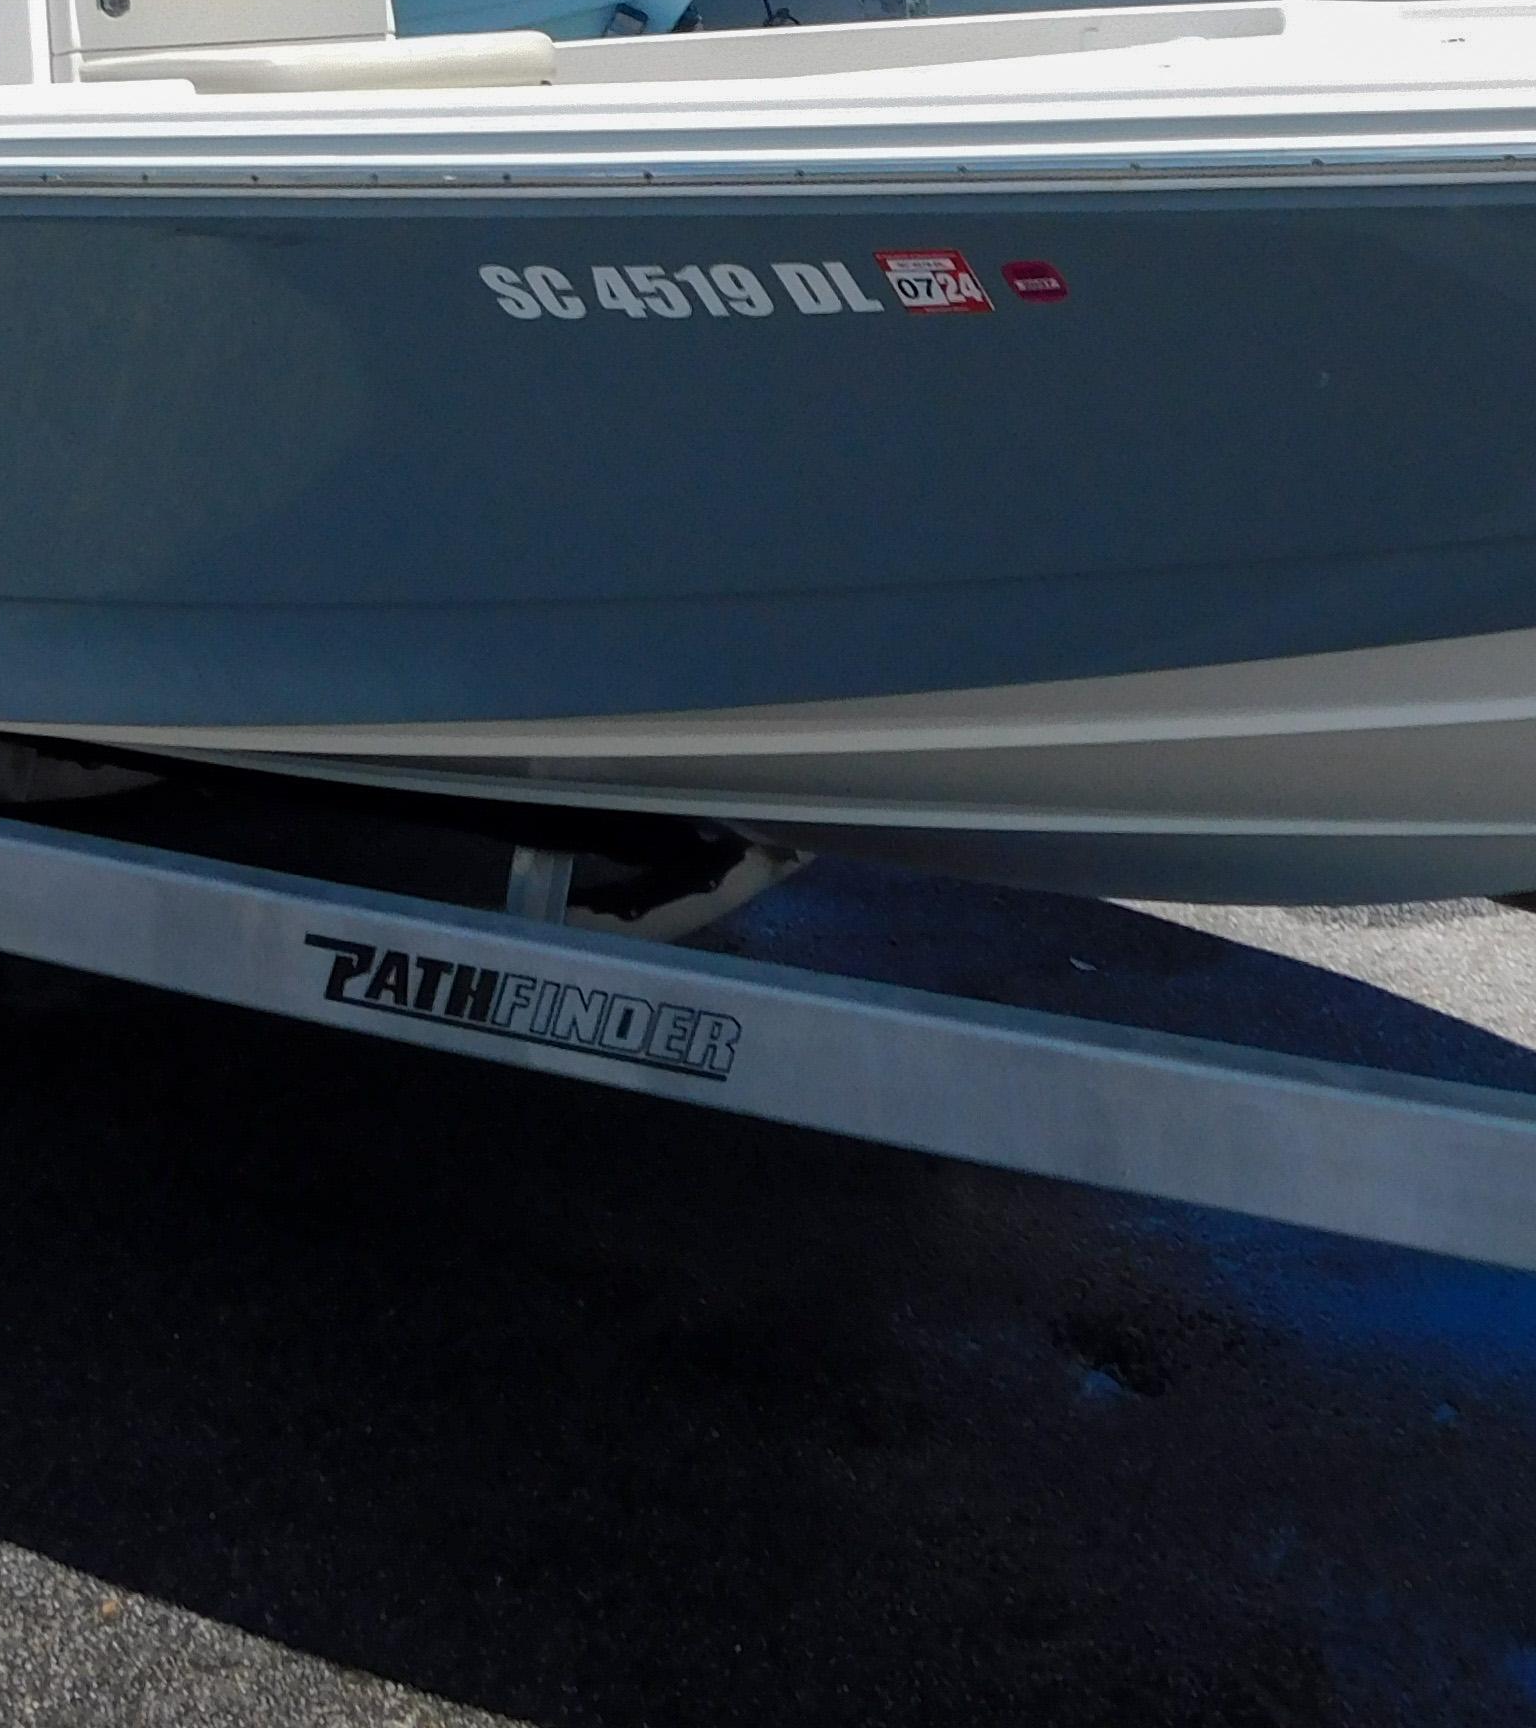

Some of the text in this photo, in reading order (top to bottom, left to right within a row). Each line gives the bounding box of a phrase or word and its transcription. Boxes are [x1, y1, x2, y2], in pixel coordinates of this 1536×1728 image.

[478, 261, 884, 319] SC 4519 DL
[305, 933, 742, 1078] PATHFINDER
